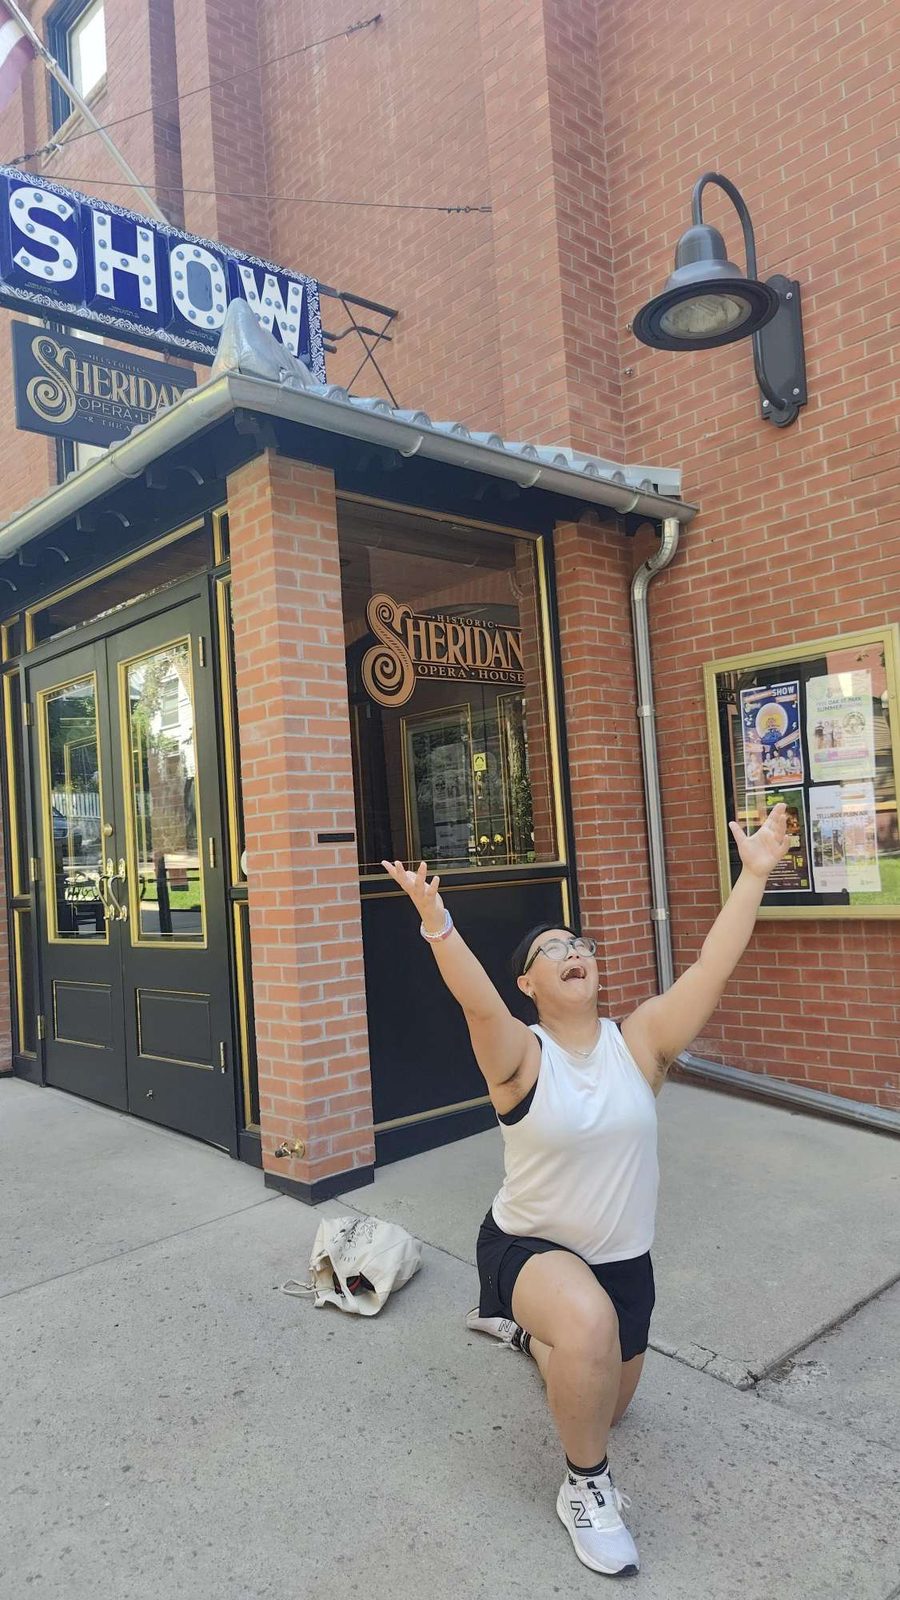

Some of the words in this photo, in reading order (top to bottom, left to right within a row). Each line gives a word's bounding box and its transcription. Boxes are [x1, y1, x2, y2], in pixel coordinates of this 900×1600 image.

[9, 187, 303, 356] SHOW
[78, 398, 132, 421] OPERA
[437, 614, 494, 628] HISTORIC
[362, 593, 524, 708] SHERIDAN
[418, 666, 467, 678] OPERA
[480, 670, 525, 681] HOUSE
[772, 686, 794, 696] SHOW
